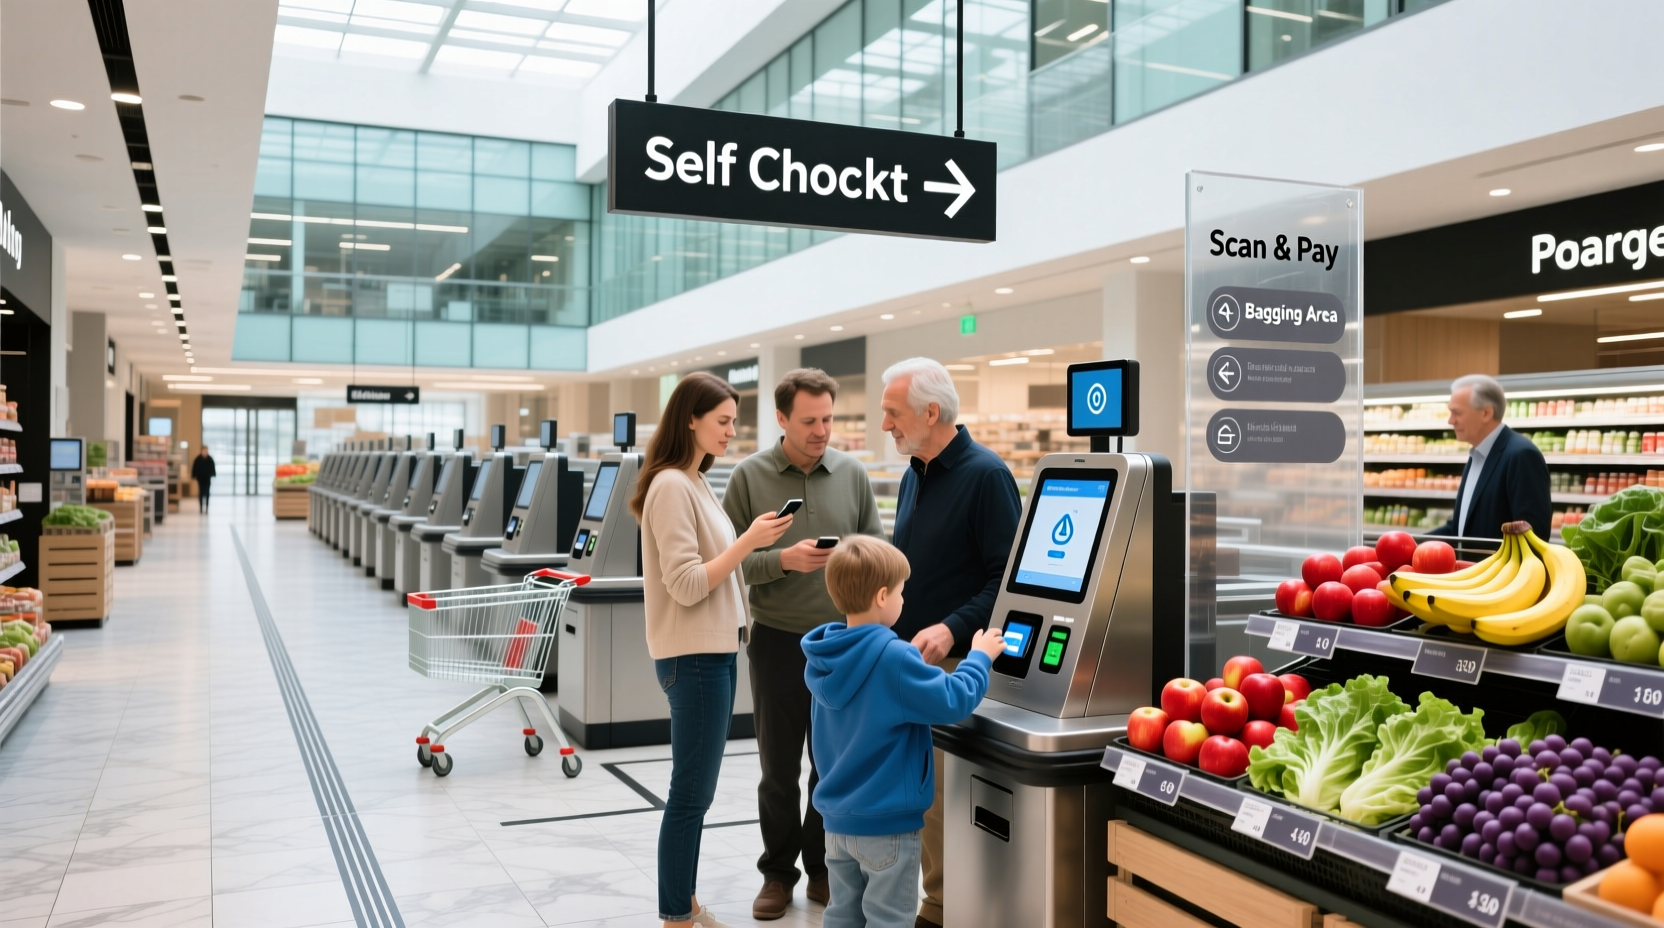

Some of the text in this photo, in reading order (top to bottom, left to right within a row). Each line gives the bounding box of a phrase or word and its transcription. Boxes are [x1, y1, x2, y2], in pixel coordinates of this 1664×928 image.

[645, 135, 909, 203] Self Chockt
[1209, 229, 1339, 271] Scan & Pay
[1531, 225, 1664, 274] Poarge
[1245, 302, 1338, 326] Bagging Area
